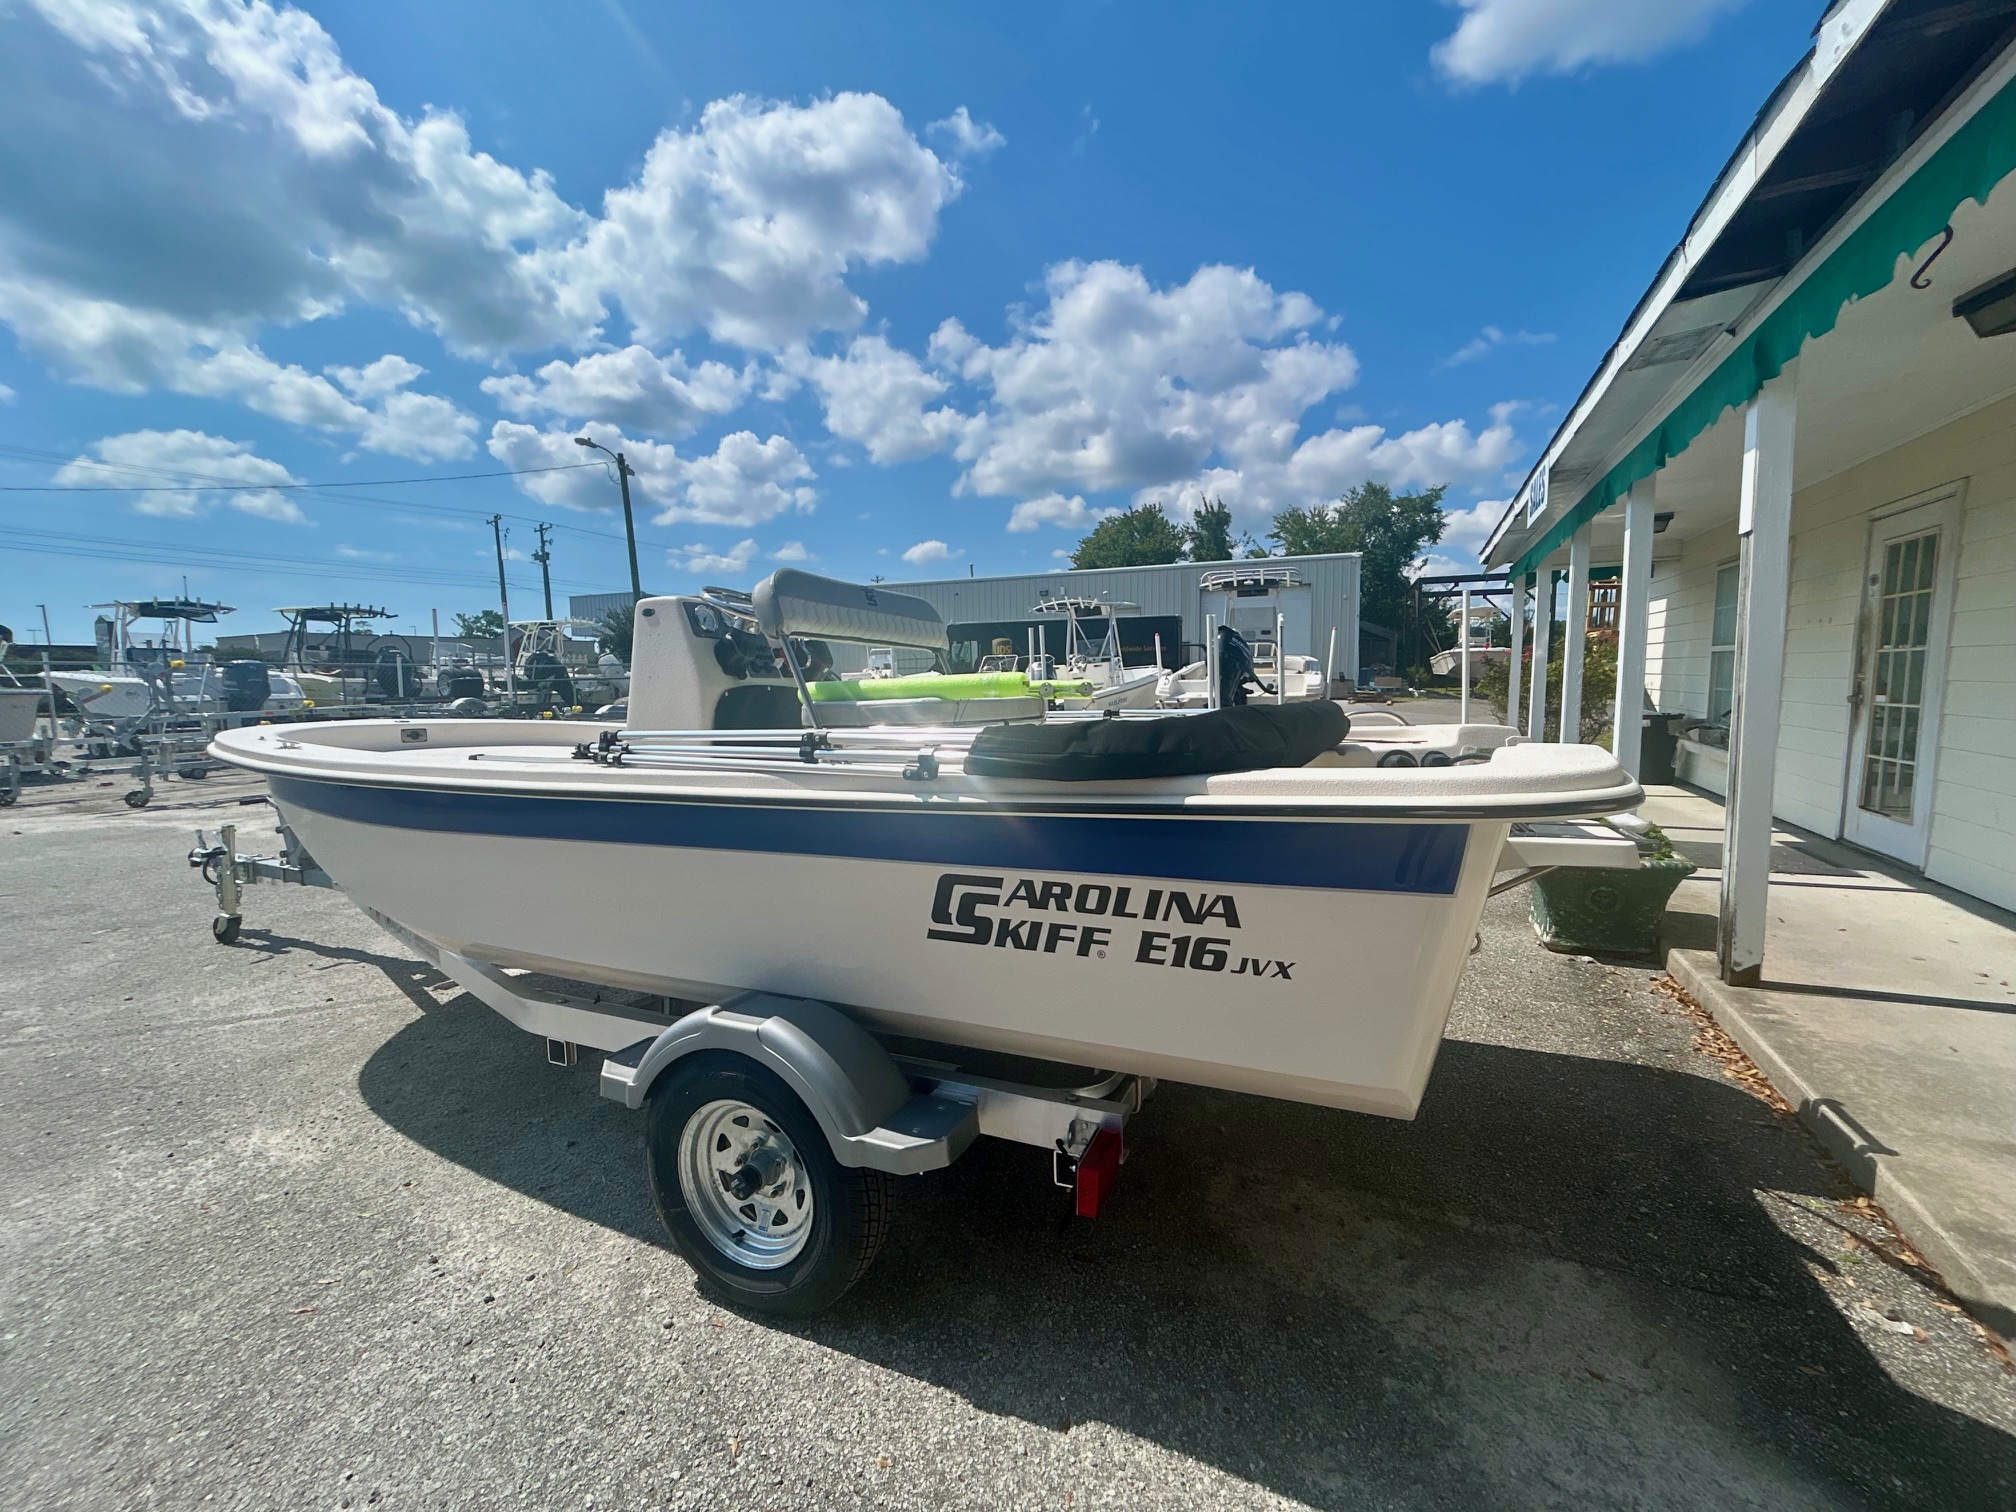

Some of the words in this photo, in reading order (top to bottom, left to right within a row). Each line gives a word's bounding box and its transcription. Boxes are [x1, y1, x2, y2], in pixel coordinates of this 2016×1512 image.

[1530, 464, 1546, 518] SALES
[994, 644, 1011, 655] UPS
[931, 873, 1242, 929] CAROLINA
[1135, 930, 1231, 972] E16
